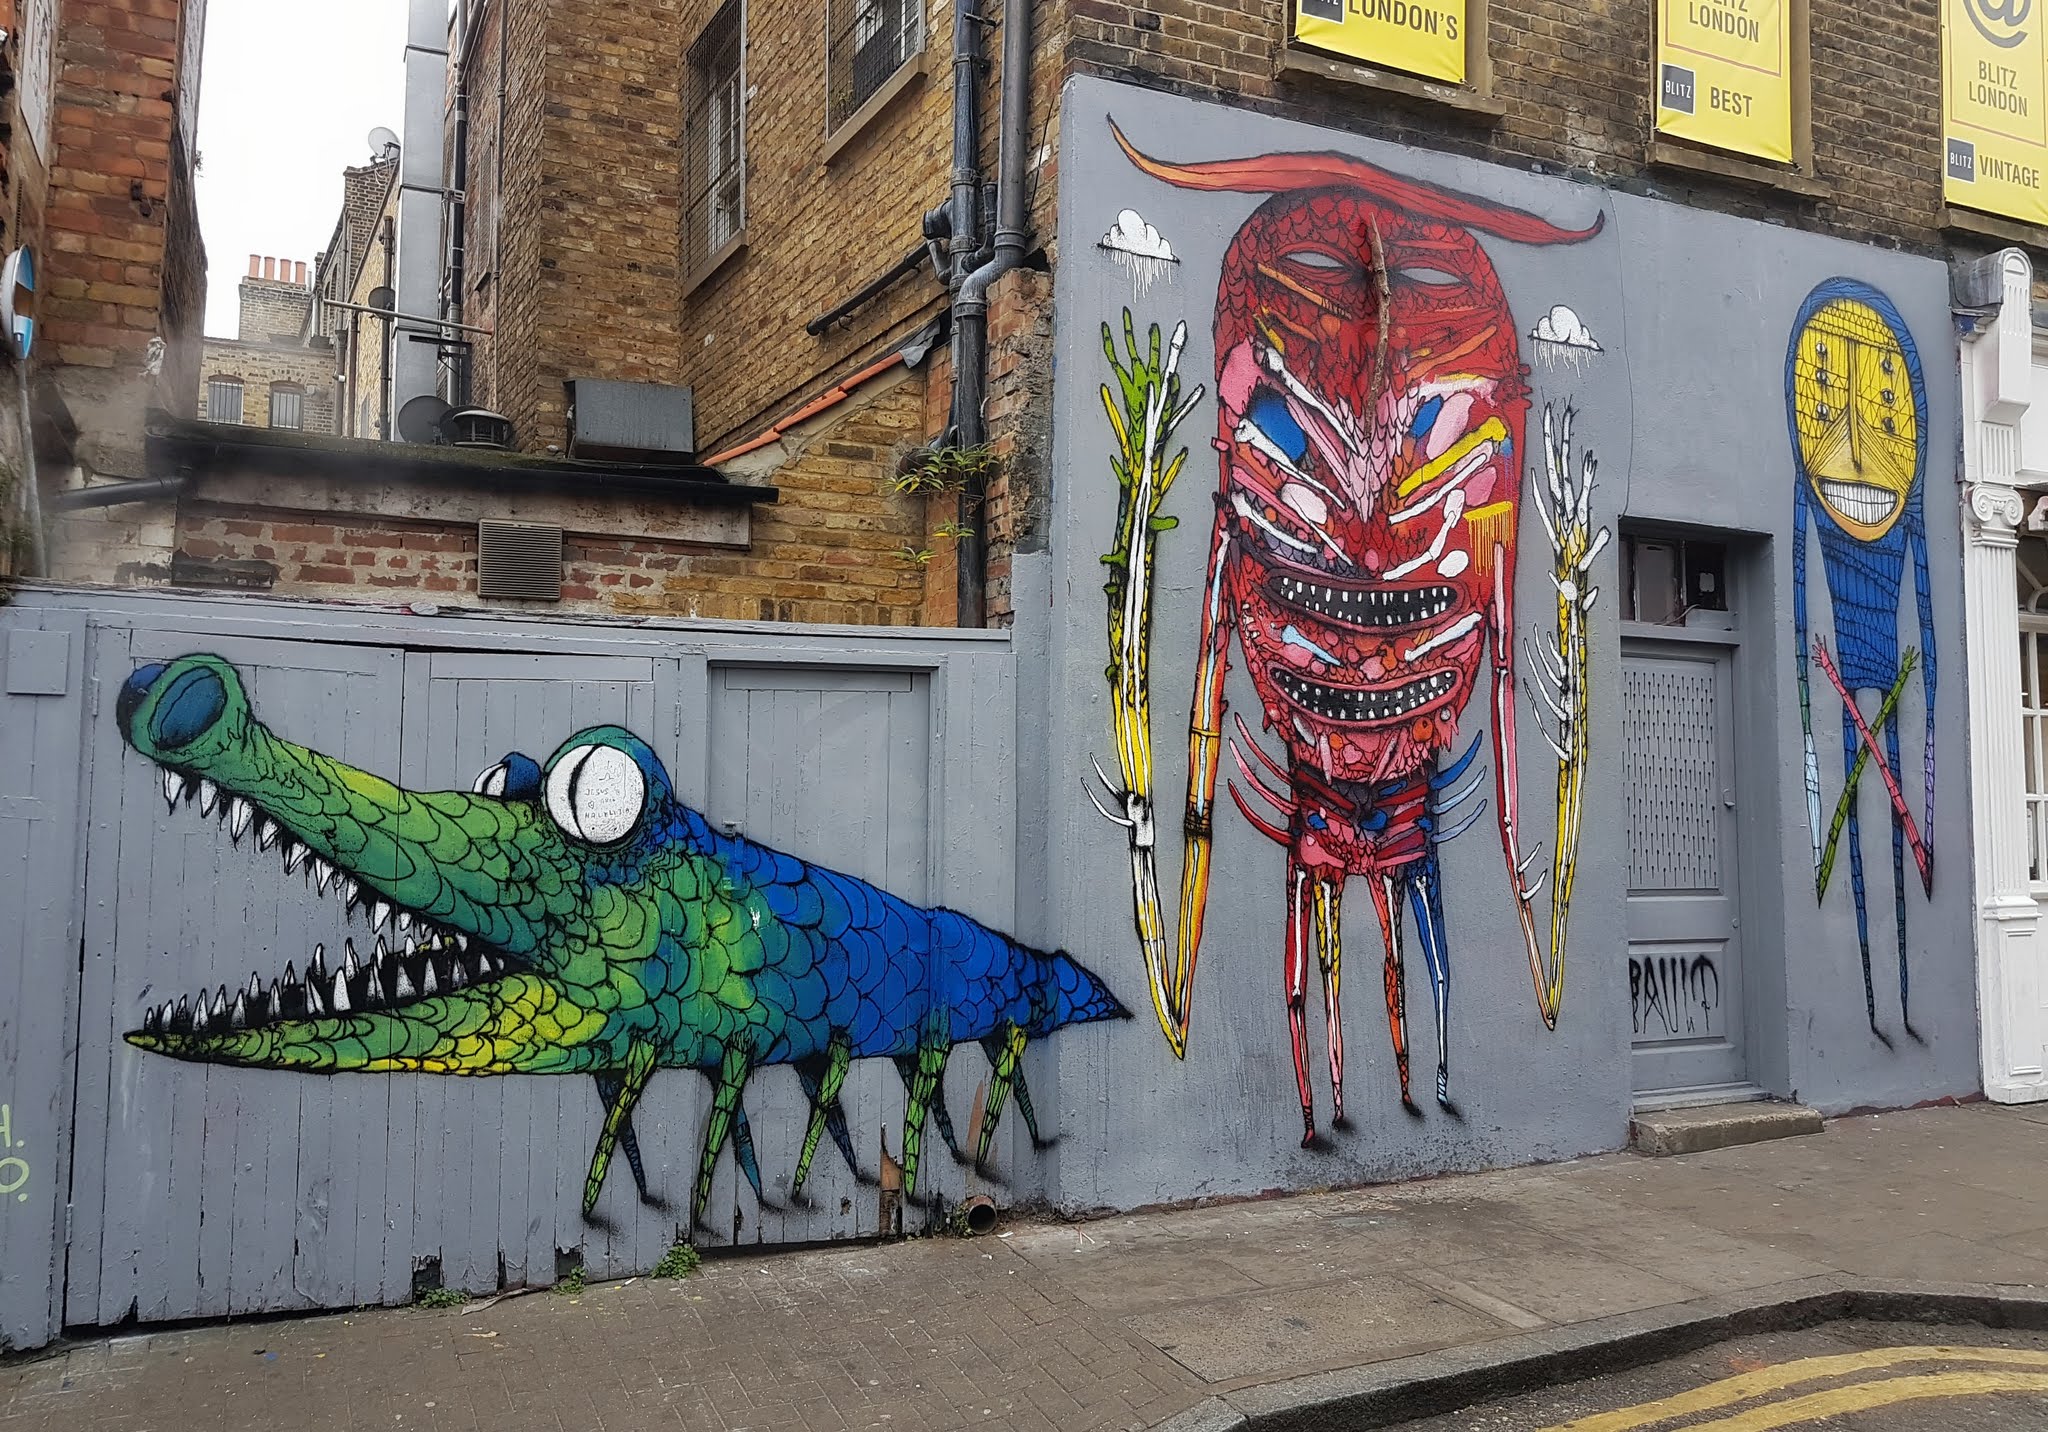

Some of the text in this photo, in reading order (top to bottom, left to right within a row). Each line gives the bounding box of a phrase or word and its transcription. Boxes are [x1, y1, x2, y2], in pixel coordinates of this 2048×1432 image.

[1348, 0, 1458, 40] LONDON'S
[1689, 1, 1759, 43] LONDON
[1665, 80, 1691, 99] BLITZ
[1978, 59, 2017, 91] BLITZ
[1710, 86, 1753, 117] BEST
[1969, 80, 2028, 117] LONDON
[1950, 152, 1972, 169] BLITZ
[1979, 154, 2039, 190] VINTAGE
